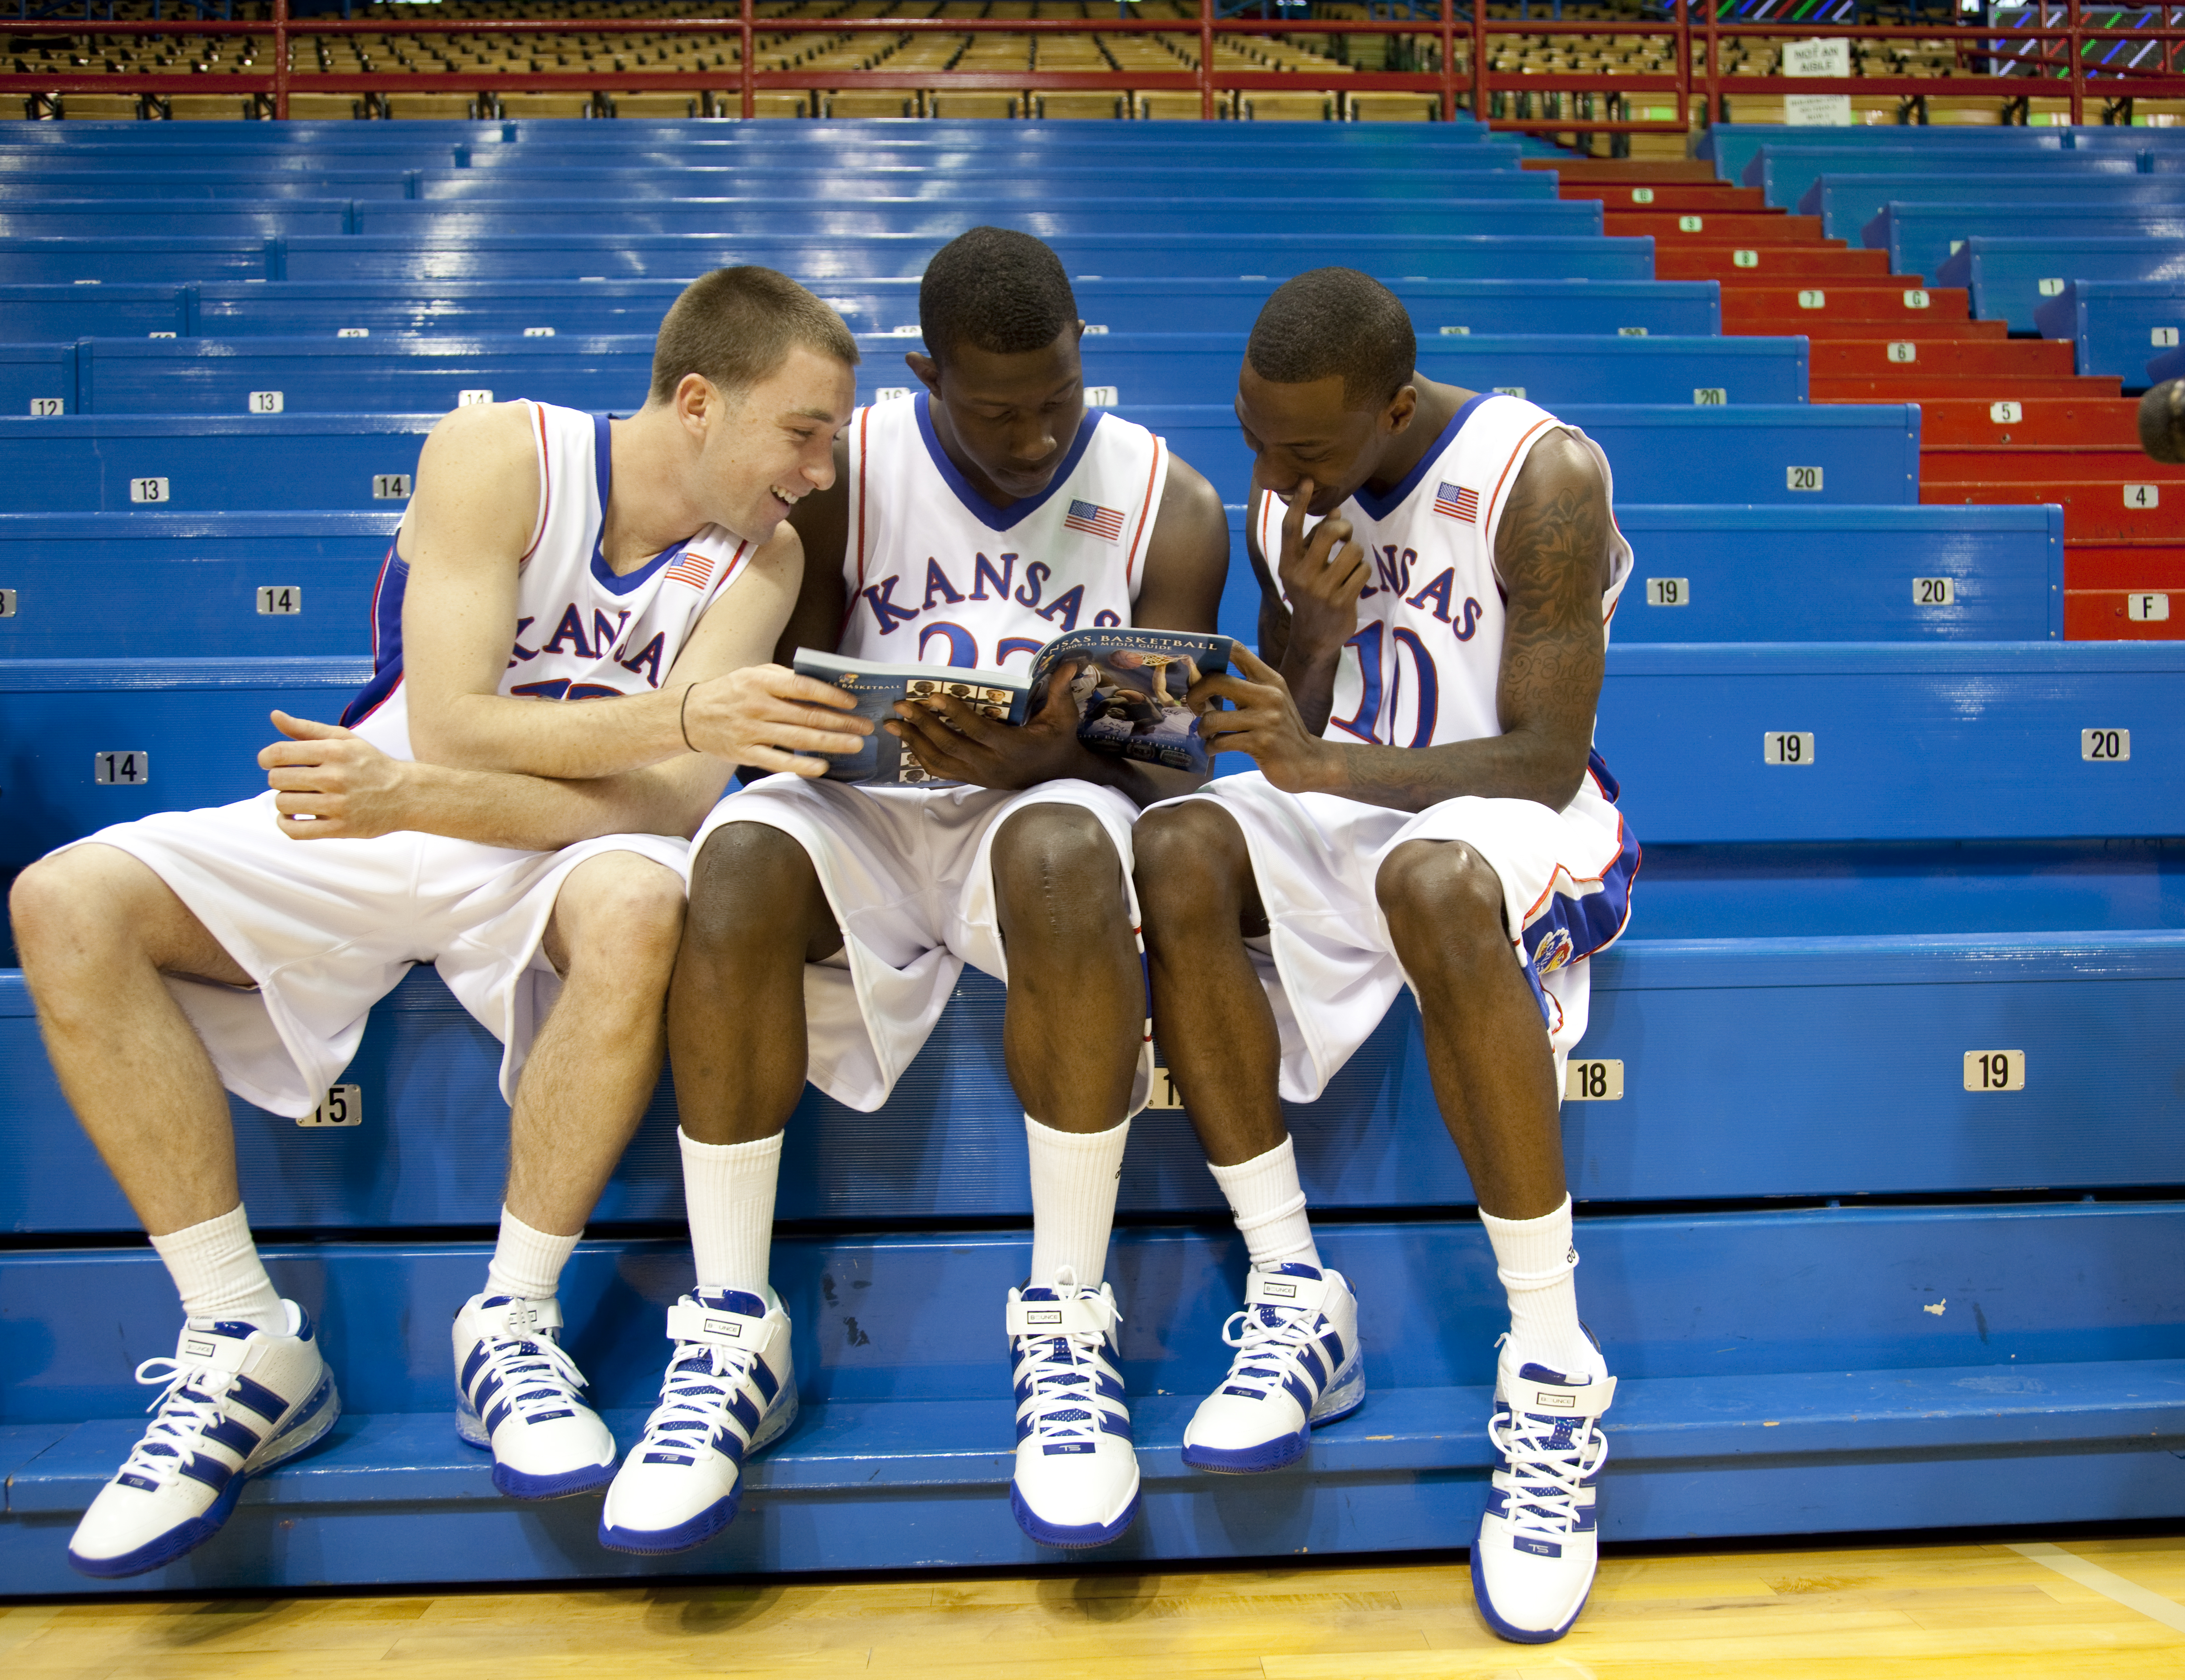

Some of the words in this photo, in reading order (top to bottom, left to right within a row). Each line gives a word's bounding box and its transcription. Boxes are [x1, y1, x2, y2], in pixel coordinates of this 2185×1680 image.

[1807, 292, 1815, 305] 7
[2163, 328, 2168, 344] 1
[1898, 344, 1907, 360] 6
[259, 394, 274, 410] 13
[1094, 389, 1107, 405] 17
[1701, 389, 1721, 404] 20
[39, 400, 57, 415] 12
[2001, 403, 2010, 420] 5
[381, 477, 403, 496] 14
[1795, 468, 1815, 488] 20
[140, 480, 159, 500] 13
[2136, 486, 2146, 505] 4
[266, 589, 292, 612] 14
[1360, 544, 1483, 642] NSAS
[1657, 580, 1678, 603] 19
[1922, 580, 1944, 602] 20
[2143, 596, 2153, 618] F
[919, 621, 1046, 669] 2
[1061, 642, 1097, 652] 2009-10
[1101, 636, 1217, 650] BASKETBALL
[1330, 619, 1439, 748] 10
[1147, 741, 1186, 752] TITLES
[1777, 734, 1801, 762] 19
[2092, 731, 2119, 758] 20
[106, 754, 137, 782] 14
[1578, 1063, 1607, 1097] 18
[1979, 1053, 2008, 1088] 19
[708, 1323, 737, 1332] BUNCE
